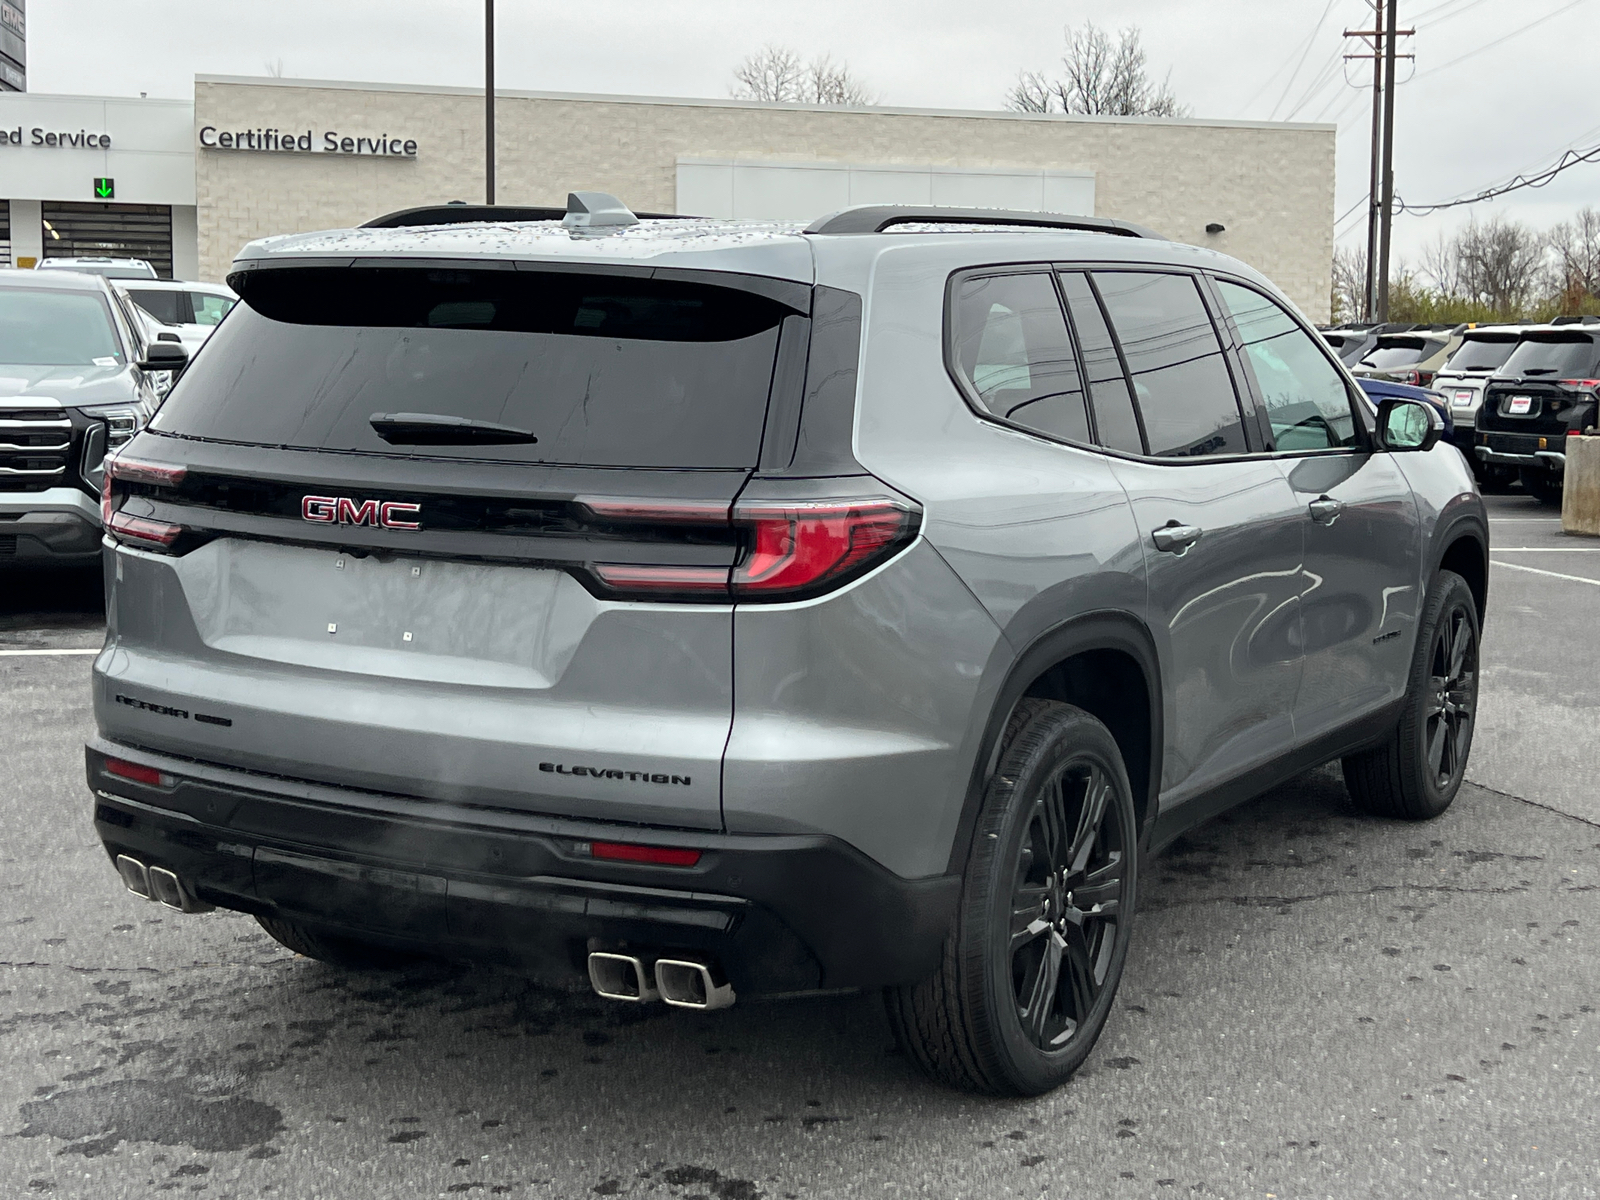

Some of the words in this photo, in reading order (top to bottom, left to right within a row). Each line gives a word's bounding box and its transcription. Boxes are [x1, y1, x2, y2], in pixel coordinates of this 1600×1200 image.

[2, 3, 25, 35] GMC
[31, 127, 111, 148] Service
[199, 126, 312, 150] Certified
[323, 131, 418, 155] Service
[302, 495, 421, 531] GMC
[539, 762, 691, 786] ELEVATION
